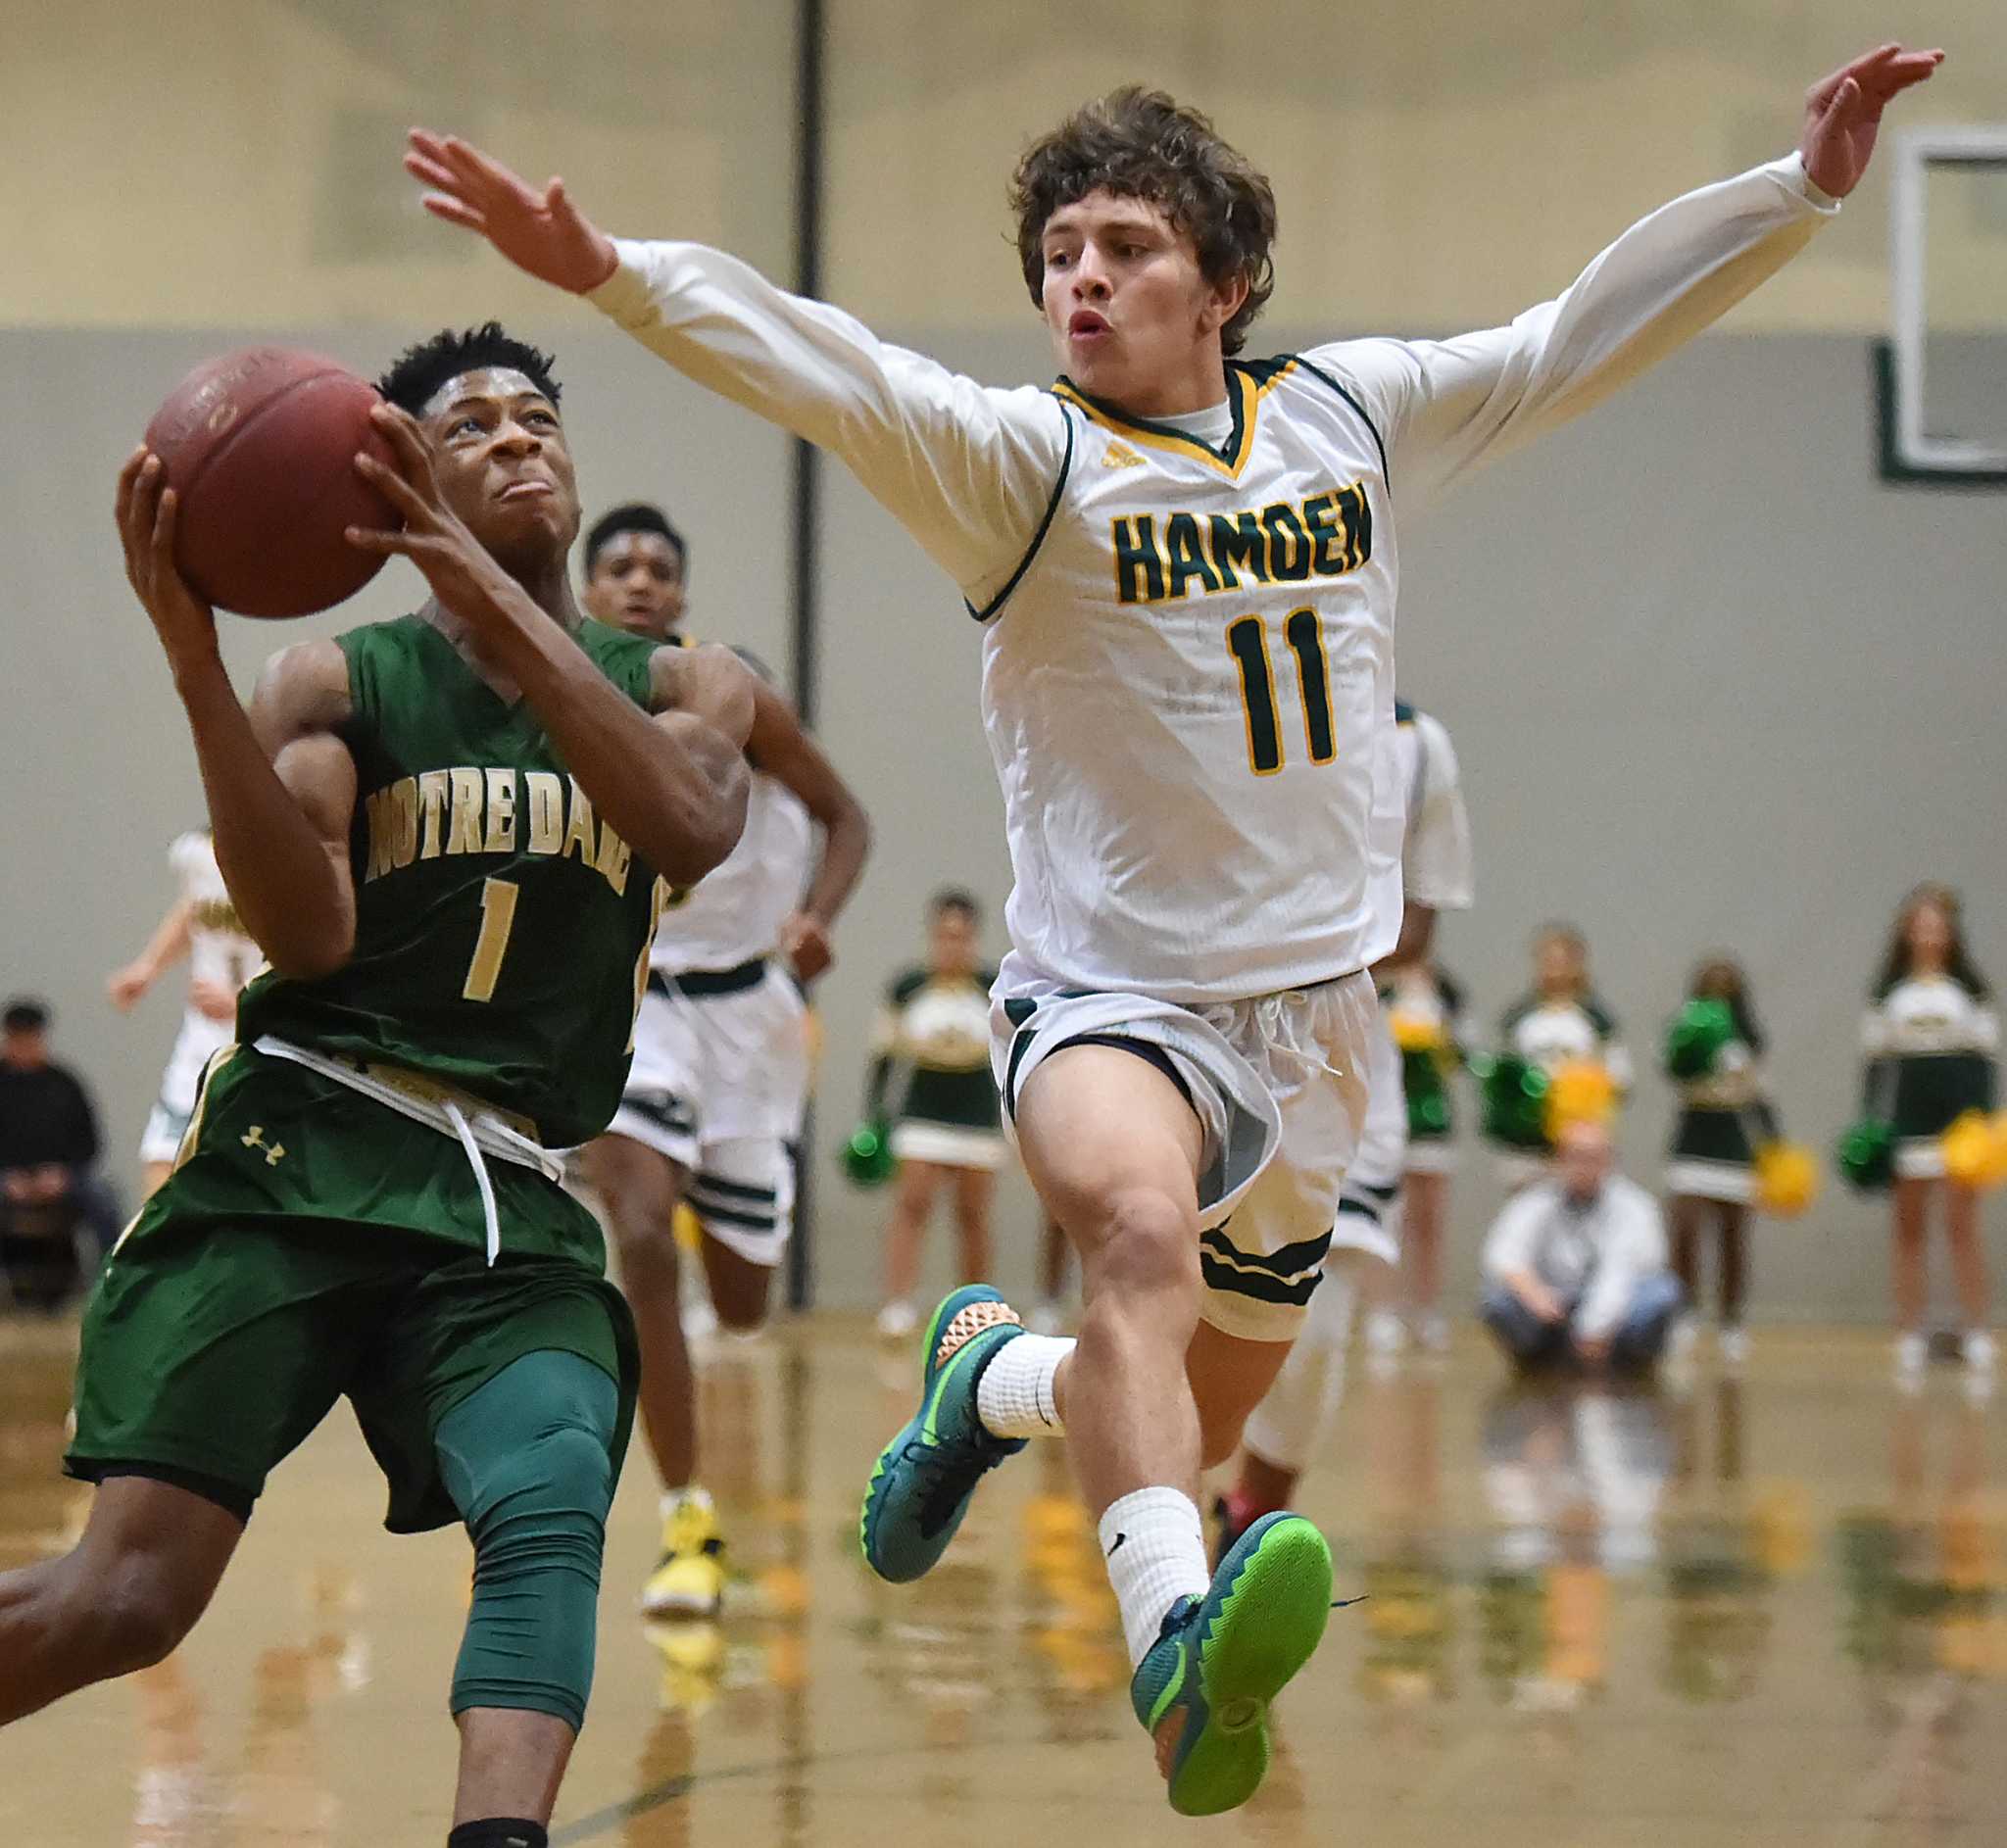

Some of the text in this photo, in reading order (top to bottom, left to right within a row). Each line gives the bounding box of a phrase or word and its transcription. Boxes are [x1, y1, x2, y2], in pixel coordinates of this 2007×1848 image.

[1110, 478, 1372, 606] HAMDEN
[1225, 606, 1338, 777] 11
[366, 766, 516, 883] NOTRE
[462, 877, 519, 1003] 1
